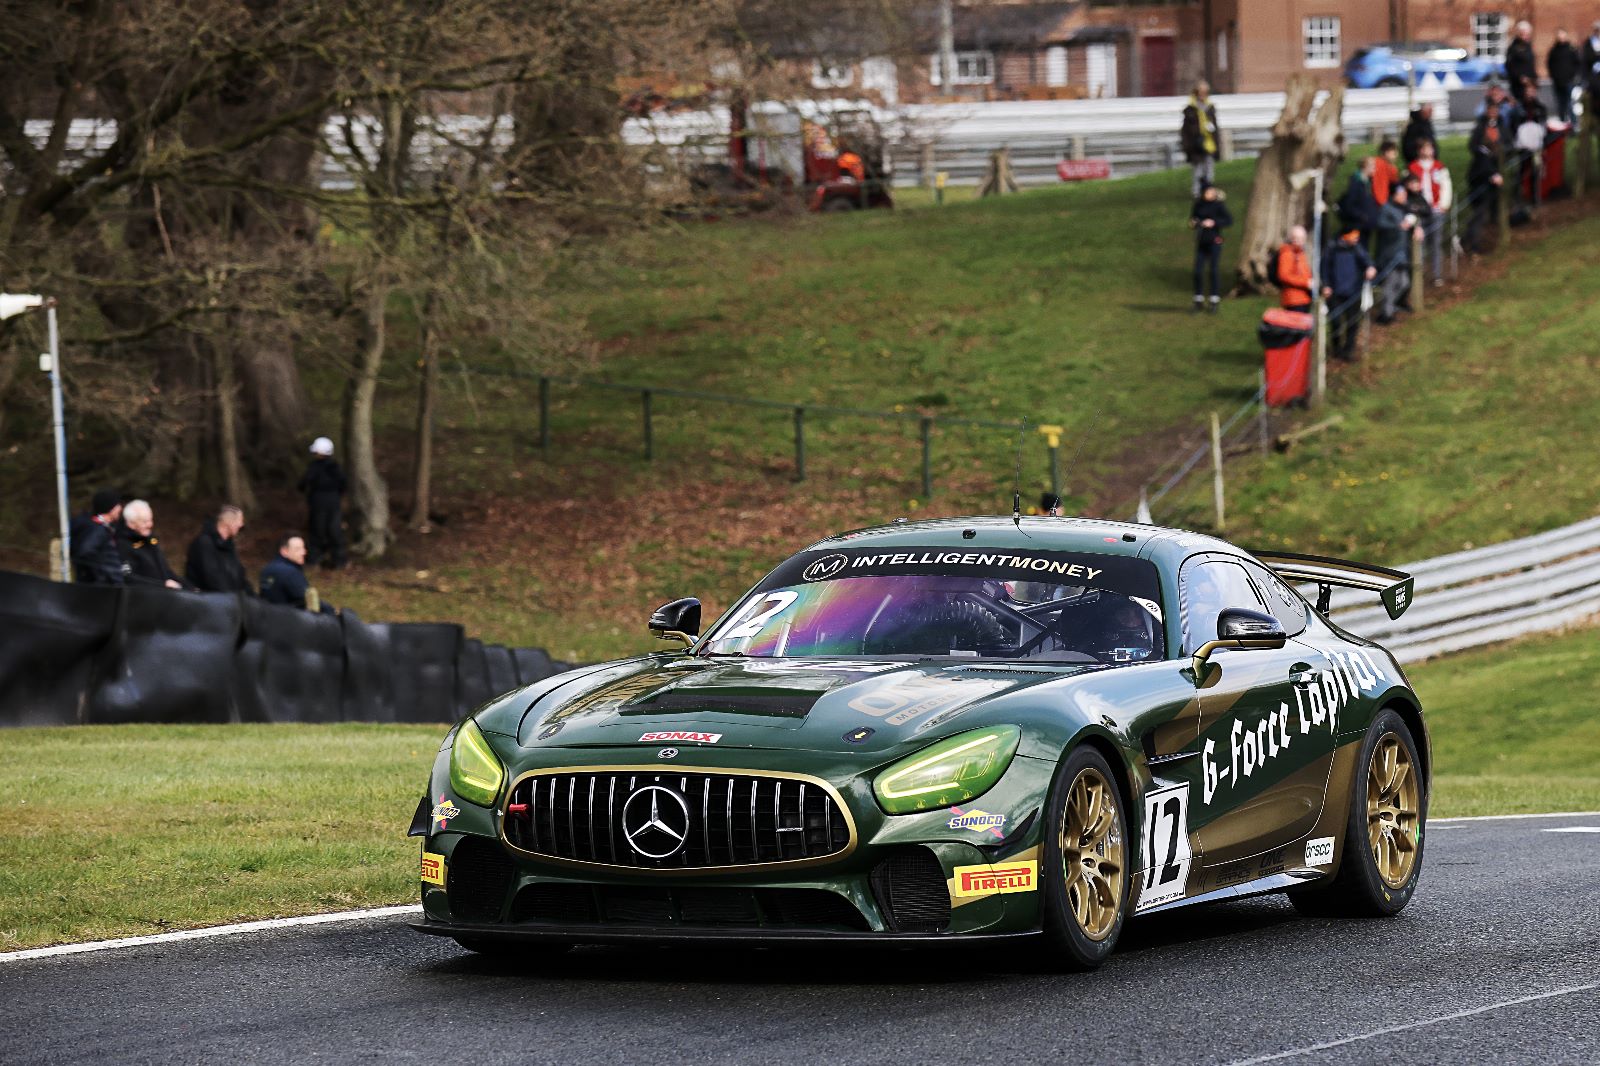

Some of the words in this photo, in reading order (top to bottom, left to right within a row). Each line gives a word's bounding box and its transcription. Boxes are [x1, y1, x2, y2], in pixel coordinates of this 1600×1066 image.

[851, 552, 1103, 580] INTELLIGENTMONEY
[711, 591, 799, 640] 12
[641, 732, 715, 742] SONAX
[951, 815, 1004, 829] SUNOCO
[1146, 796, 1181, 890] 12
[961, 867, 1032, 892] PIRELLI
